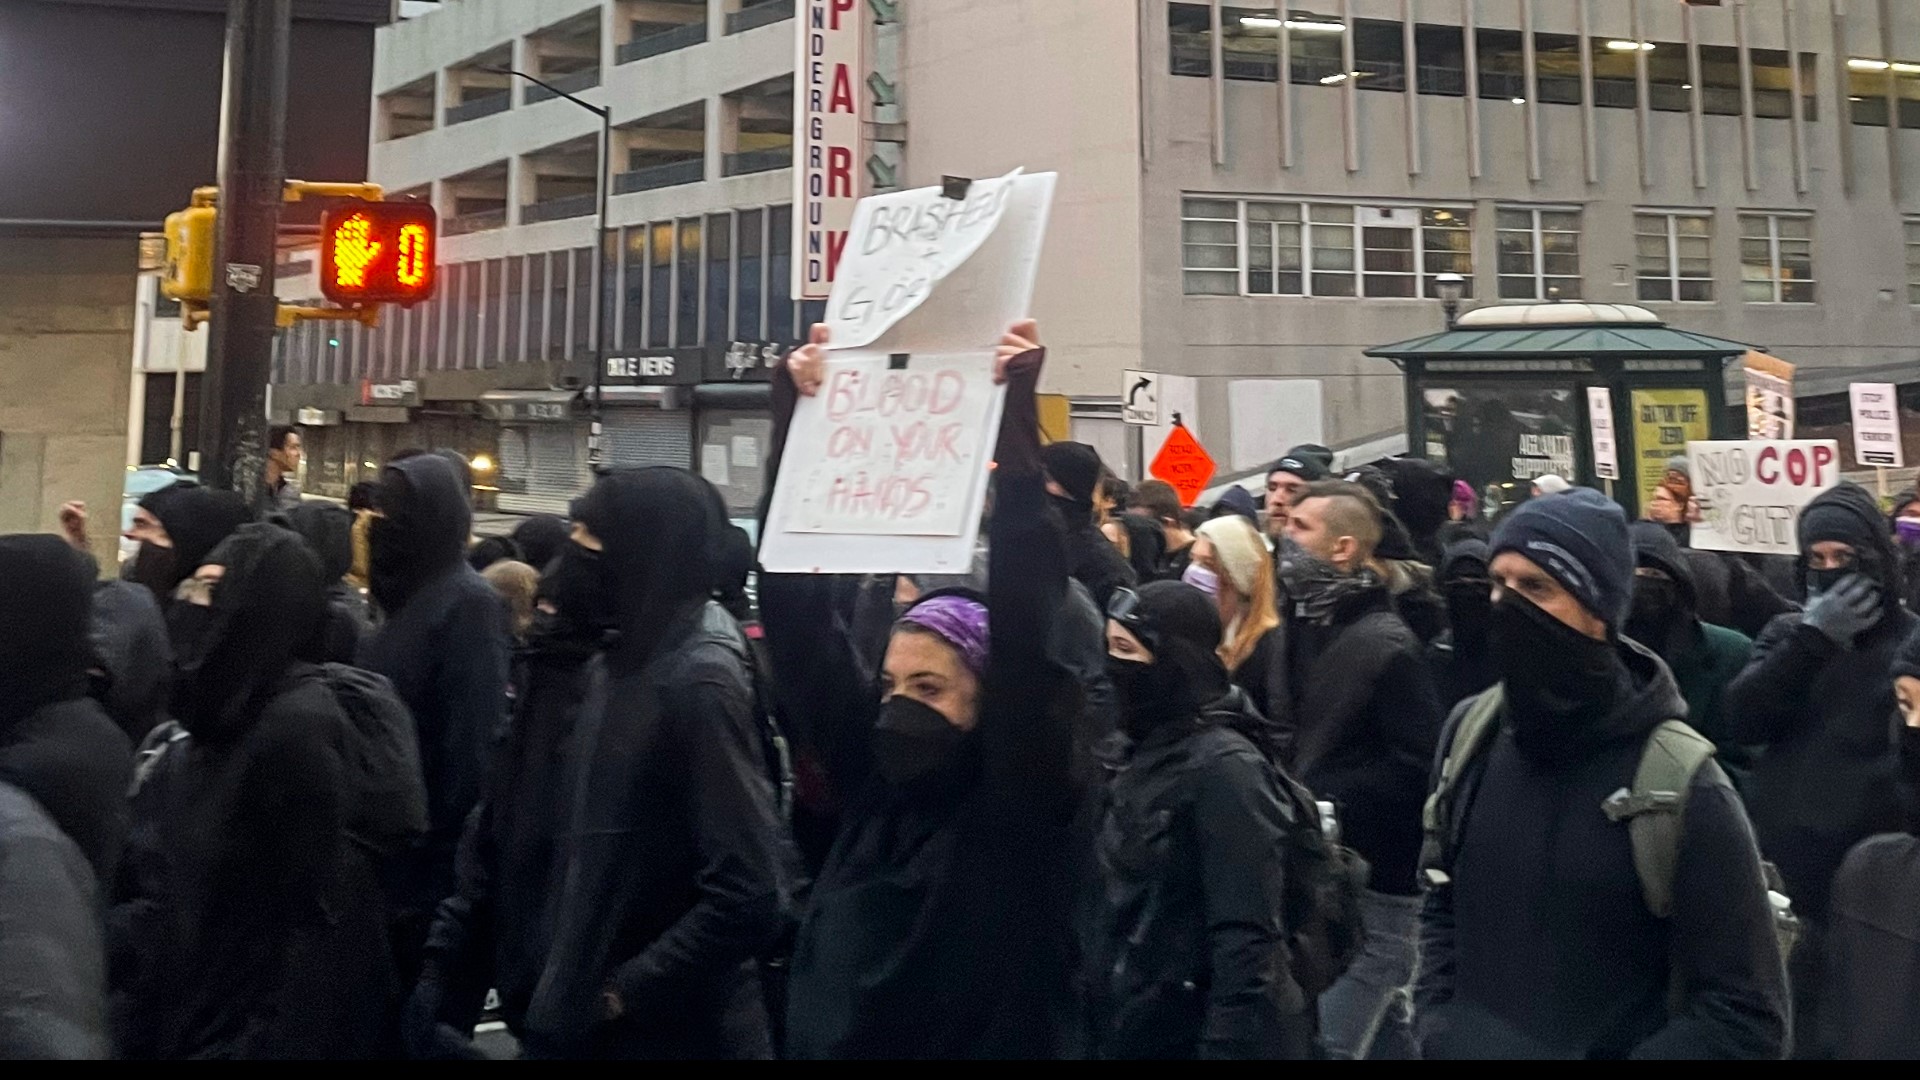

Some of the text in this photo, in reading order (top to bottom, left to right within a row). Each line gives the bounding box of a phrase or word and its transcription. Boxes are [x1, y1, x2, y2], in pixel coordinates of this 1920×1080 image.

[808, 0, 824, 283] NDERGROUND
[826, 0, 855, 283] PARK
[398, 223, 424, 286] 0
[826, 369, 967, 422] BLOOD
[827, 420, 964, 468] ON YOUR
[1697, 448, 1750, 487] NO
[1755, 445, 1832, 488] COP
